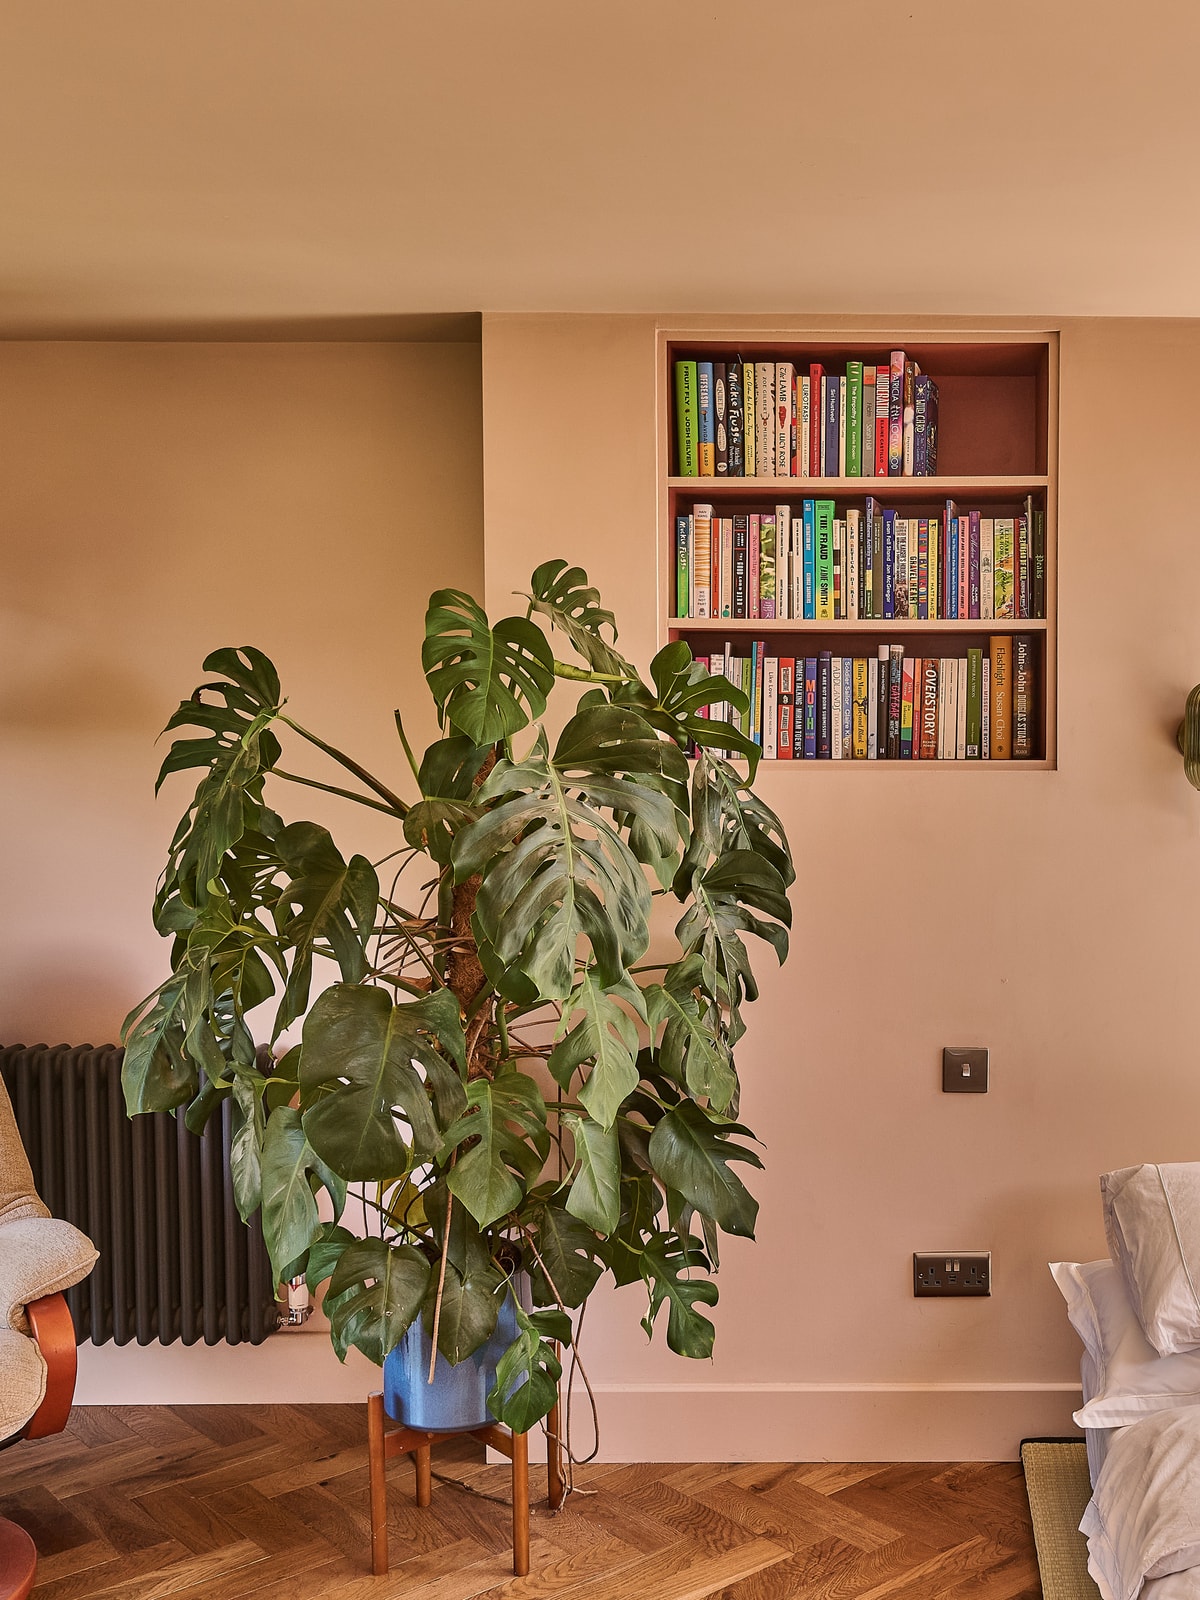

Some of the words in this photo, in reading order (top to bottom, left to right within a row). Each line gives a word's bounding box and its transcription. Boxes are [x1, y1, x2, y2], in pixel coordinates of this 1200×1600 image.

[700, 374, 708, 408] OFFSEASON
[779, 380, 787, 402] LAMB
[876, 374, 889, 418] MODERATION
[916, 400, 925, 414] WILD
[915, 415, 925, 433] CARD
[891, 423, 899, 470] LOCKWOOD
[820, 533, 828, 560] FRAUD
[970, 533, 978, 559] Modern
[820, 565, 828, 581] ZADIE
[820, 583, 828, 606] SMITH
[909, 581, 917, 605] HEART
[1018, 642, 1026, 664] John
[822, 668, 826, 676] WE
[856, 664, 864, 681] Hilary
[994, 647, 1005, 686] Flashlight
[1018, 670, 1026, 692] John
[795, 682, 803, 705] TALKING
[806, 679, 816, 730] MOTH
[890, 685, 899, 702] GAY
[924, 669, 937, 735] OVERSTORY
[996, 691, 1005, 716] Susan
[890, 702, 899, 719] BAR
[1017, 694, 1026, 723] DOUGLAS
[996, 719, 1005, 740] Choi
[1017, 723, 1026, 747] STUART
